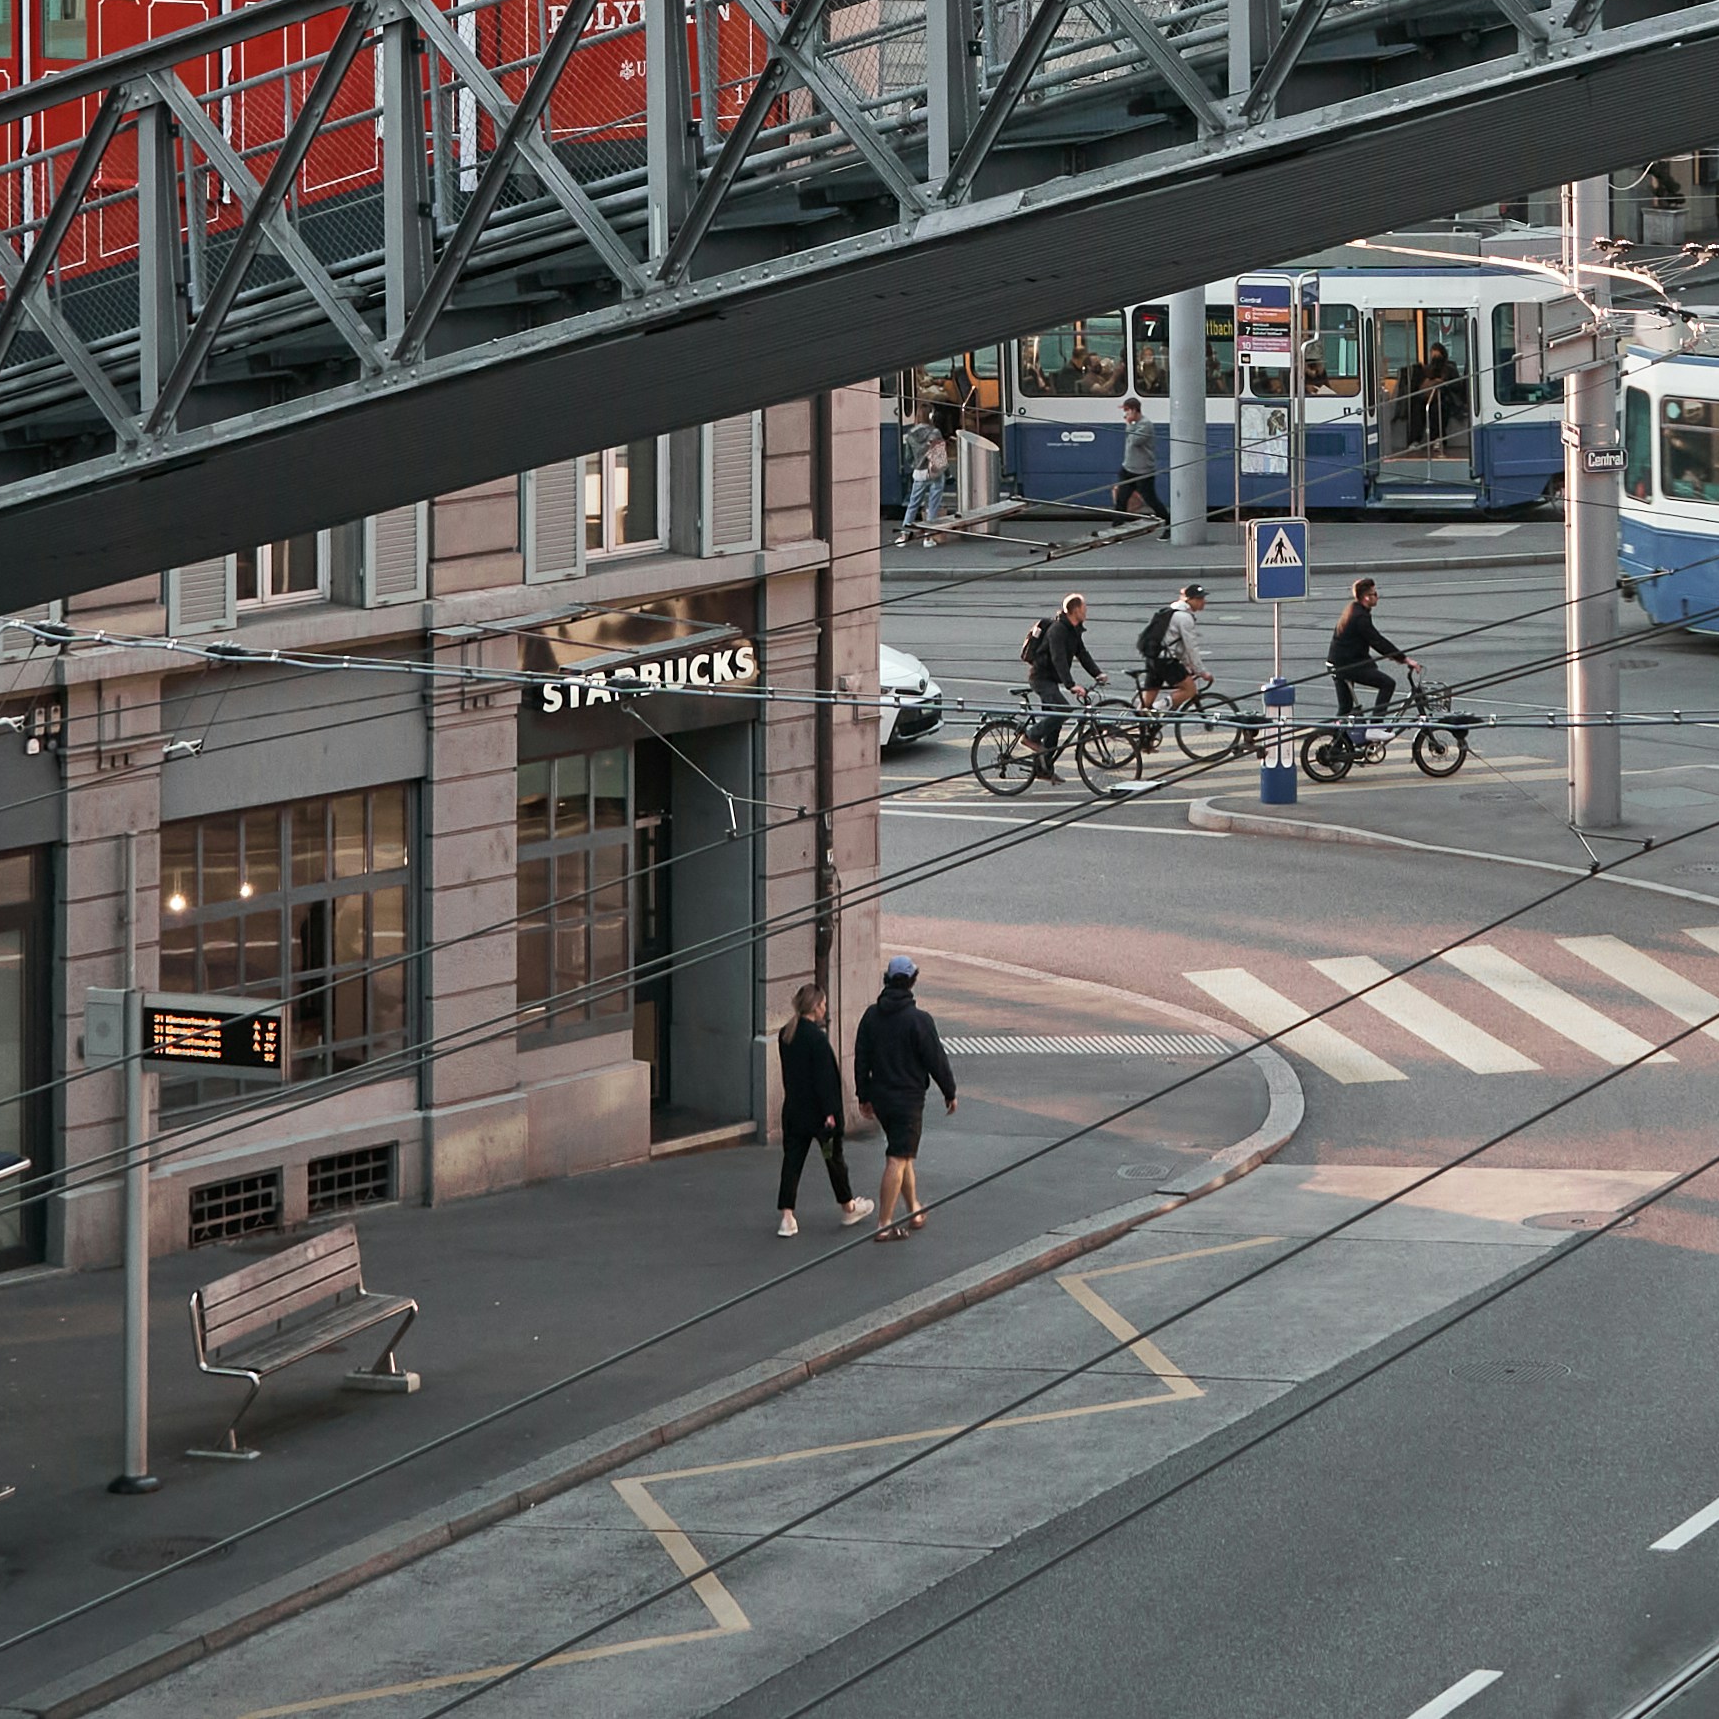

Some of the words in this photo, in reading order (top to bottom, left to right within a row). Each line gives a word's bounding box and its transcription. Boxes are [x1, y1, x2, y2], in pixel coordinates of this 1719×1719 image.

[1244, 311, 1252, 320] 6
[1144, 320, 1157, 337] 7
[1245, 326, 1252, 335] 7
[1587, 450, 1624, 467] Central
